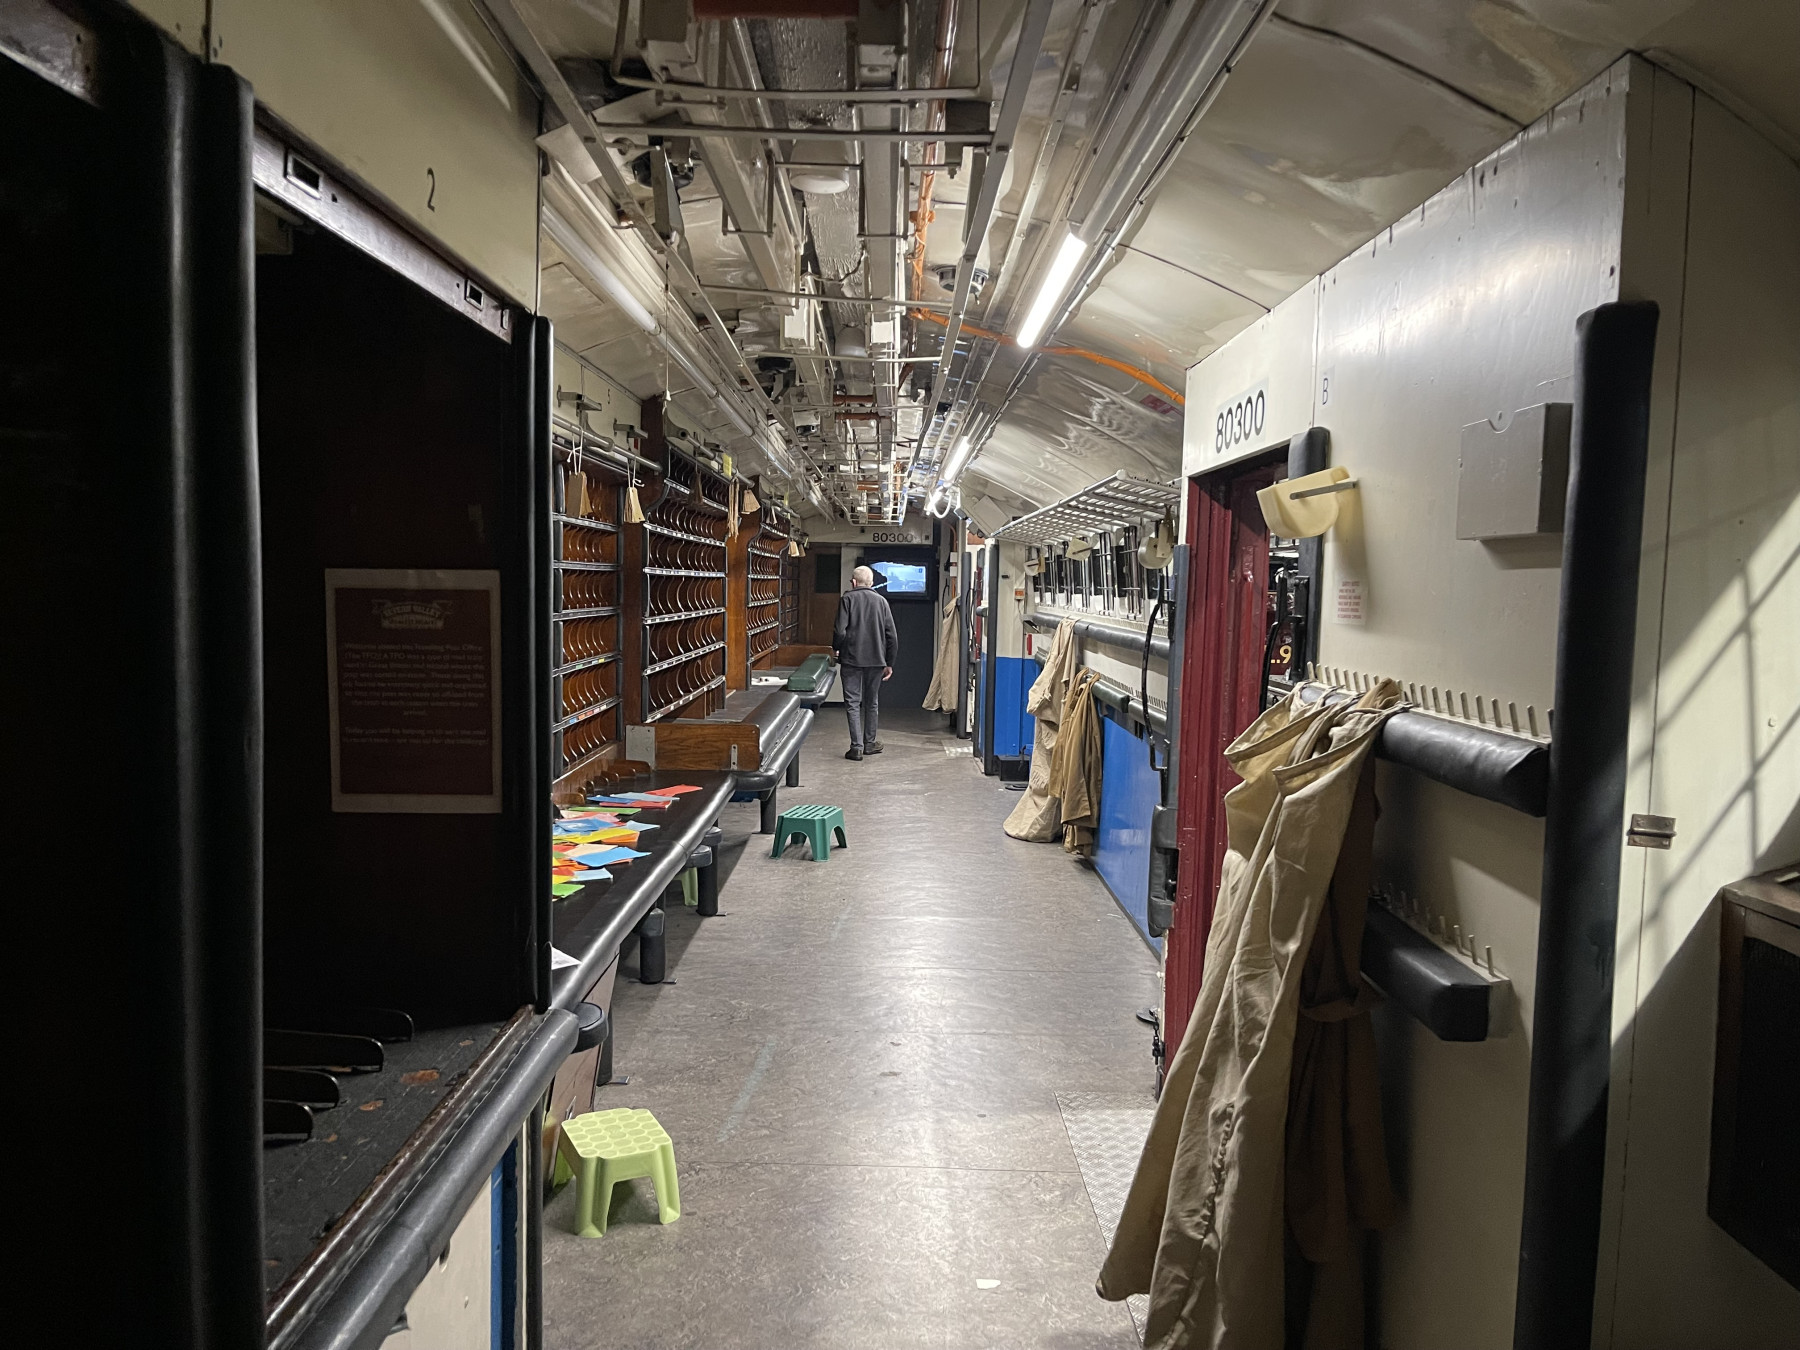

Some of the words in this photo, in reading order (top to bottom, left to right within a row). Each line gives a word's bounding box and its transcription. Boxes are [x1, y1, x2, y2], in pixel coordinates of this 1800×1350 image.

[427, 167, 436, 213] 2
[1321, 377, 1329, 405] B
[1215, 389, 1265, 454] 80300
[872, 532, 914, 543] 80300
